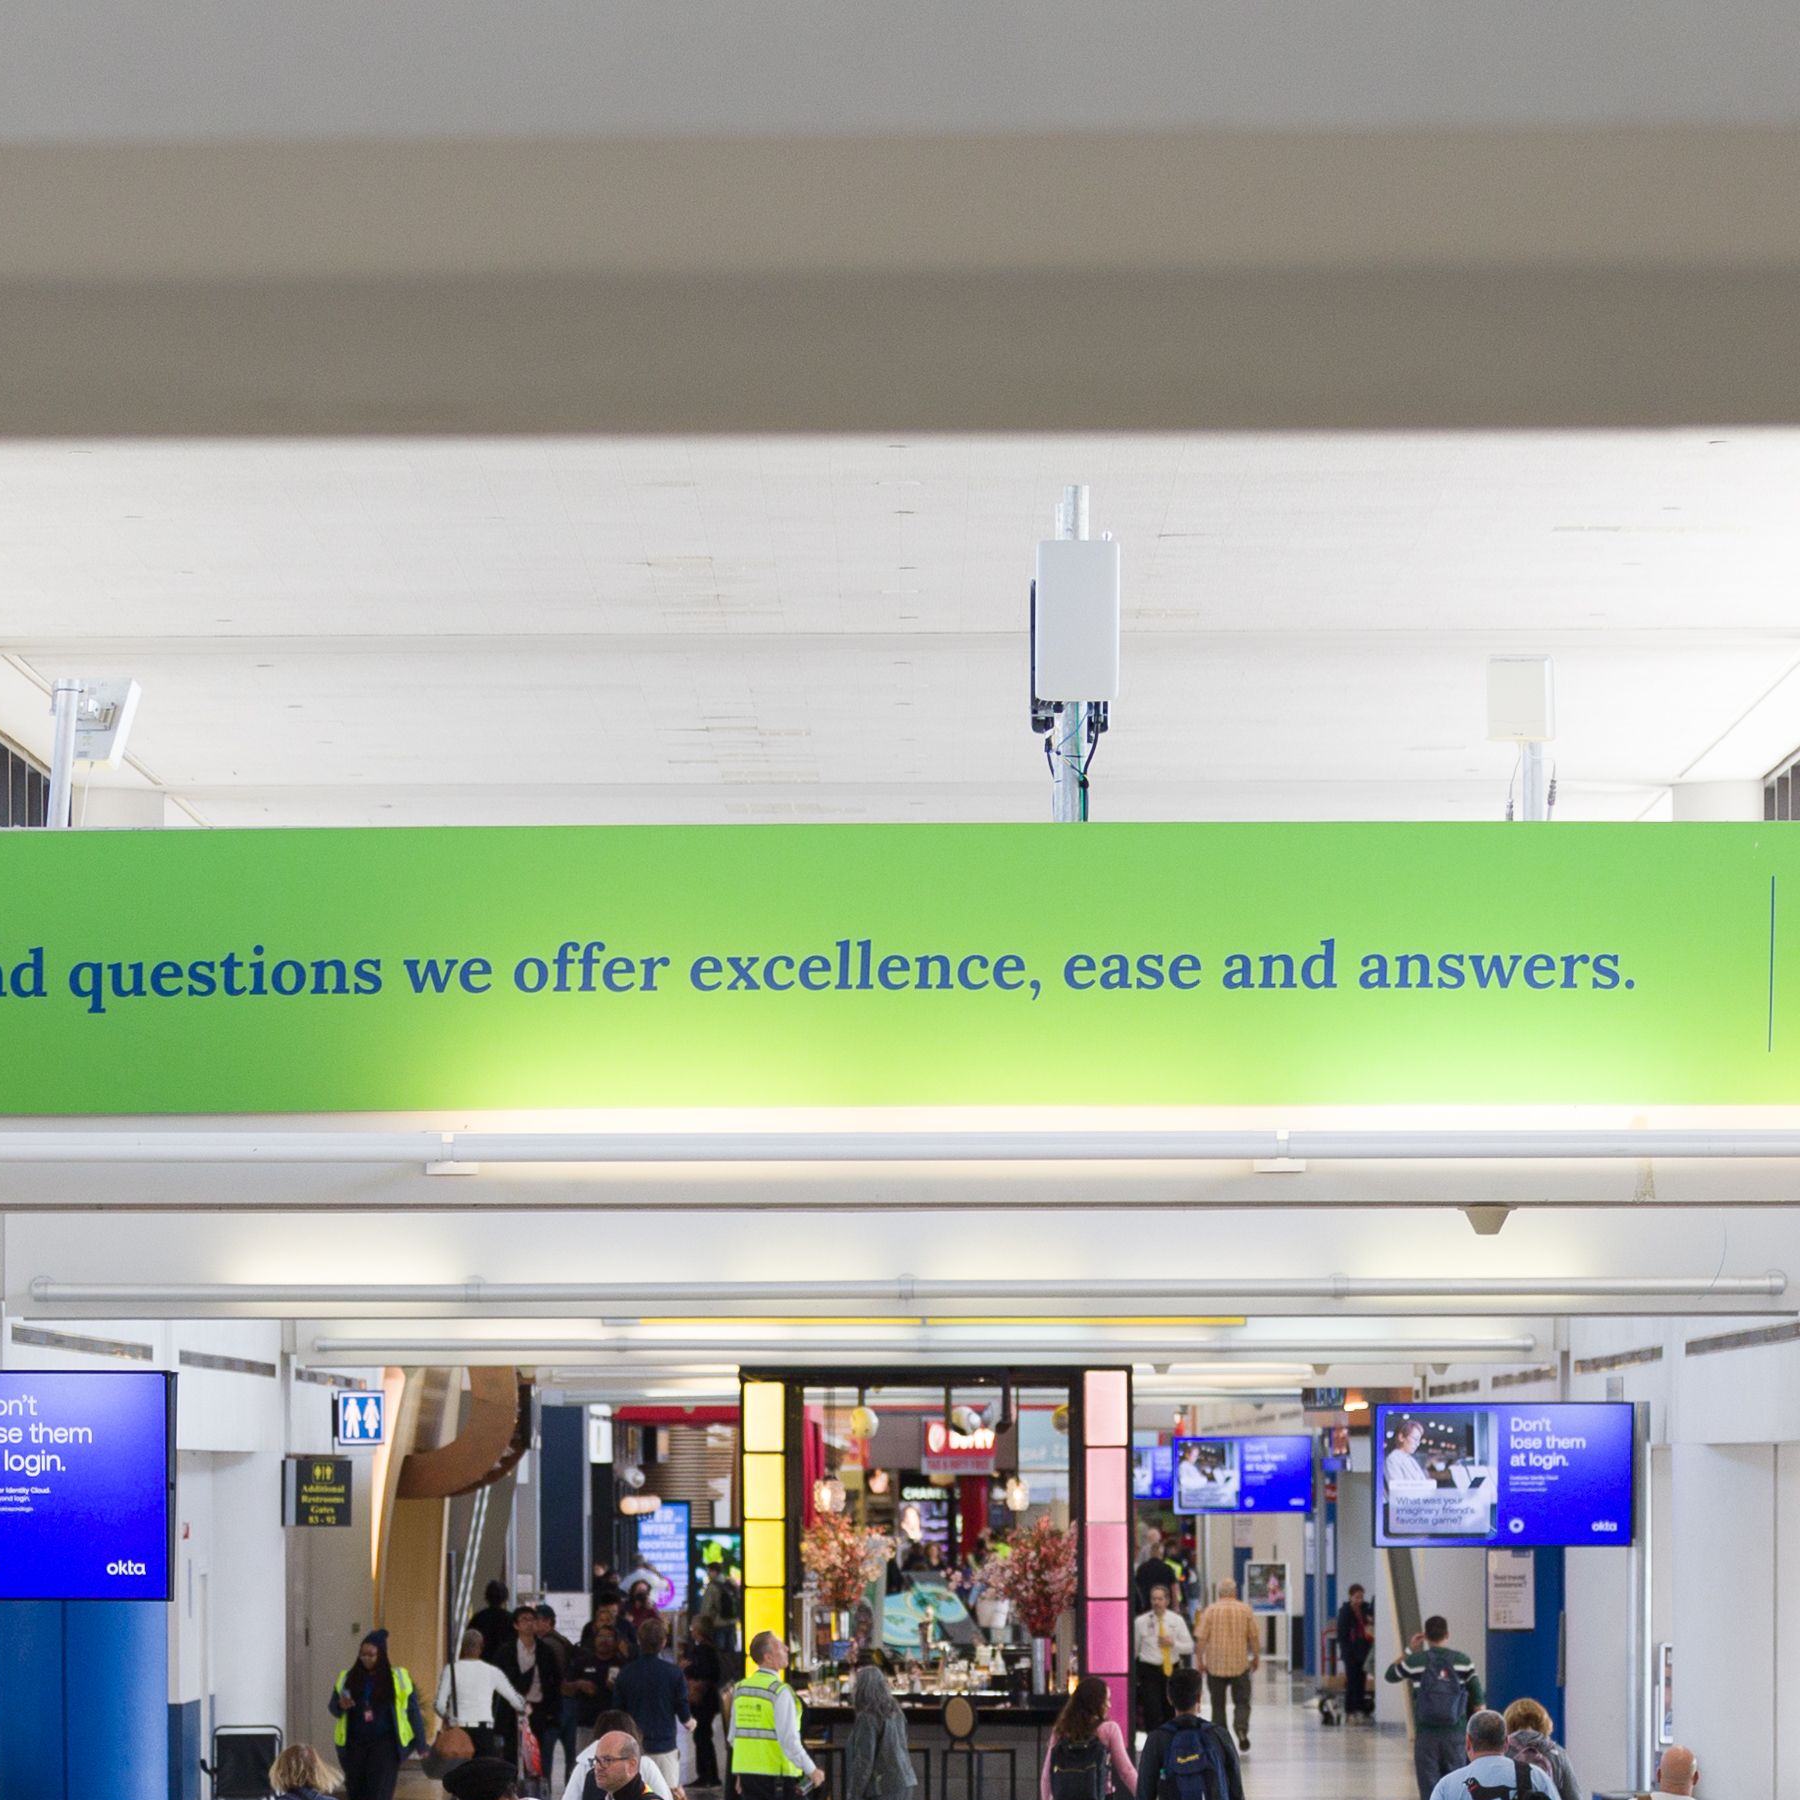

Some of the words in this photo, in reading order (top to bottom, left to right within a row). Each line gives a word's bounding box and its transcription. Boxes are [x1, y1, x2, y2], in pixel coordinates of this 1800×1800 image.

[69, 944, 384, 1014] questions
[404, 958, 493, 995] we
[514, 941, 672, 993] offer
[690, 940, 1045, 1001] excellence,
[1064, 954, 1203, 991] ease
[1223, 938, 1339, 991] and
[1359, 954, 1638, 991] answers.
[1510, 1417, 1552, 1432] Don't
[29, 1422, 93, 1444] them
[1510, 1435, 1542, 1449] lose
[1546, 1435, 1586, 1449] them
[4, 1449, 67, 1477] login.
[1510, 1453, 1526, 1467] at
[1529, 1452, 1569, 1470] login.
[301, 1484, 346, 1494] Additional
[902, 1486, 949, 1500] CHANEL
[301, 1494, 345, 1504] Restrooms
[310, 1505, 335, 1514] Gates
[1396, 1507, 1440, 1516] imaginary
[1396, 1516, 1429, 1525] favorite
[1591, 1520, 1618, 1532] okta
[106, 1559, 147, 1576] okta
